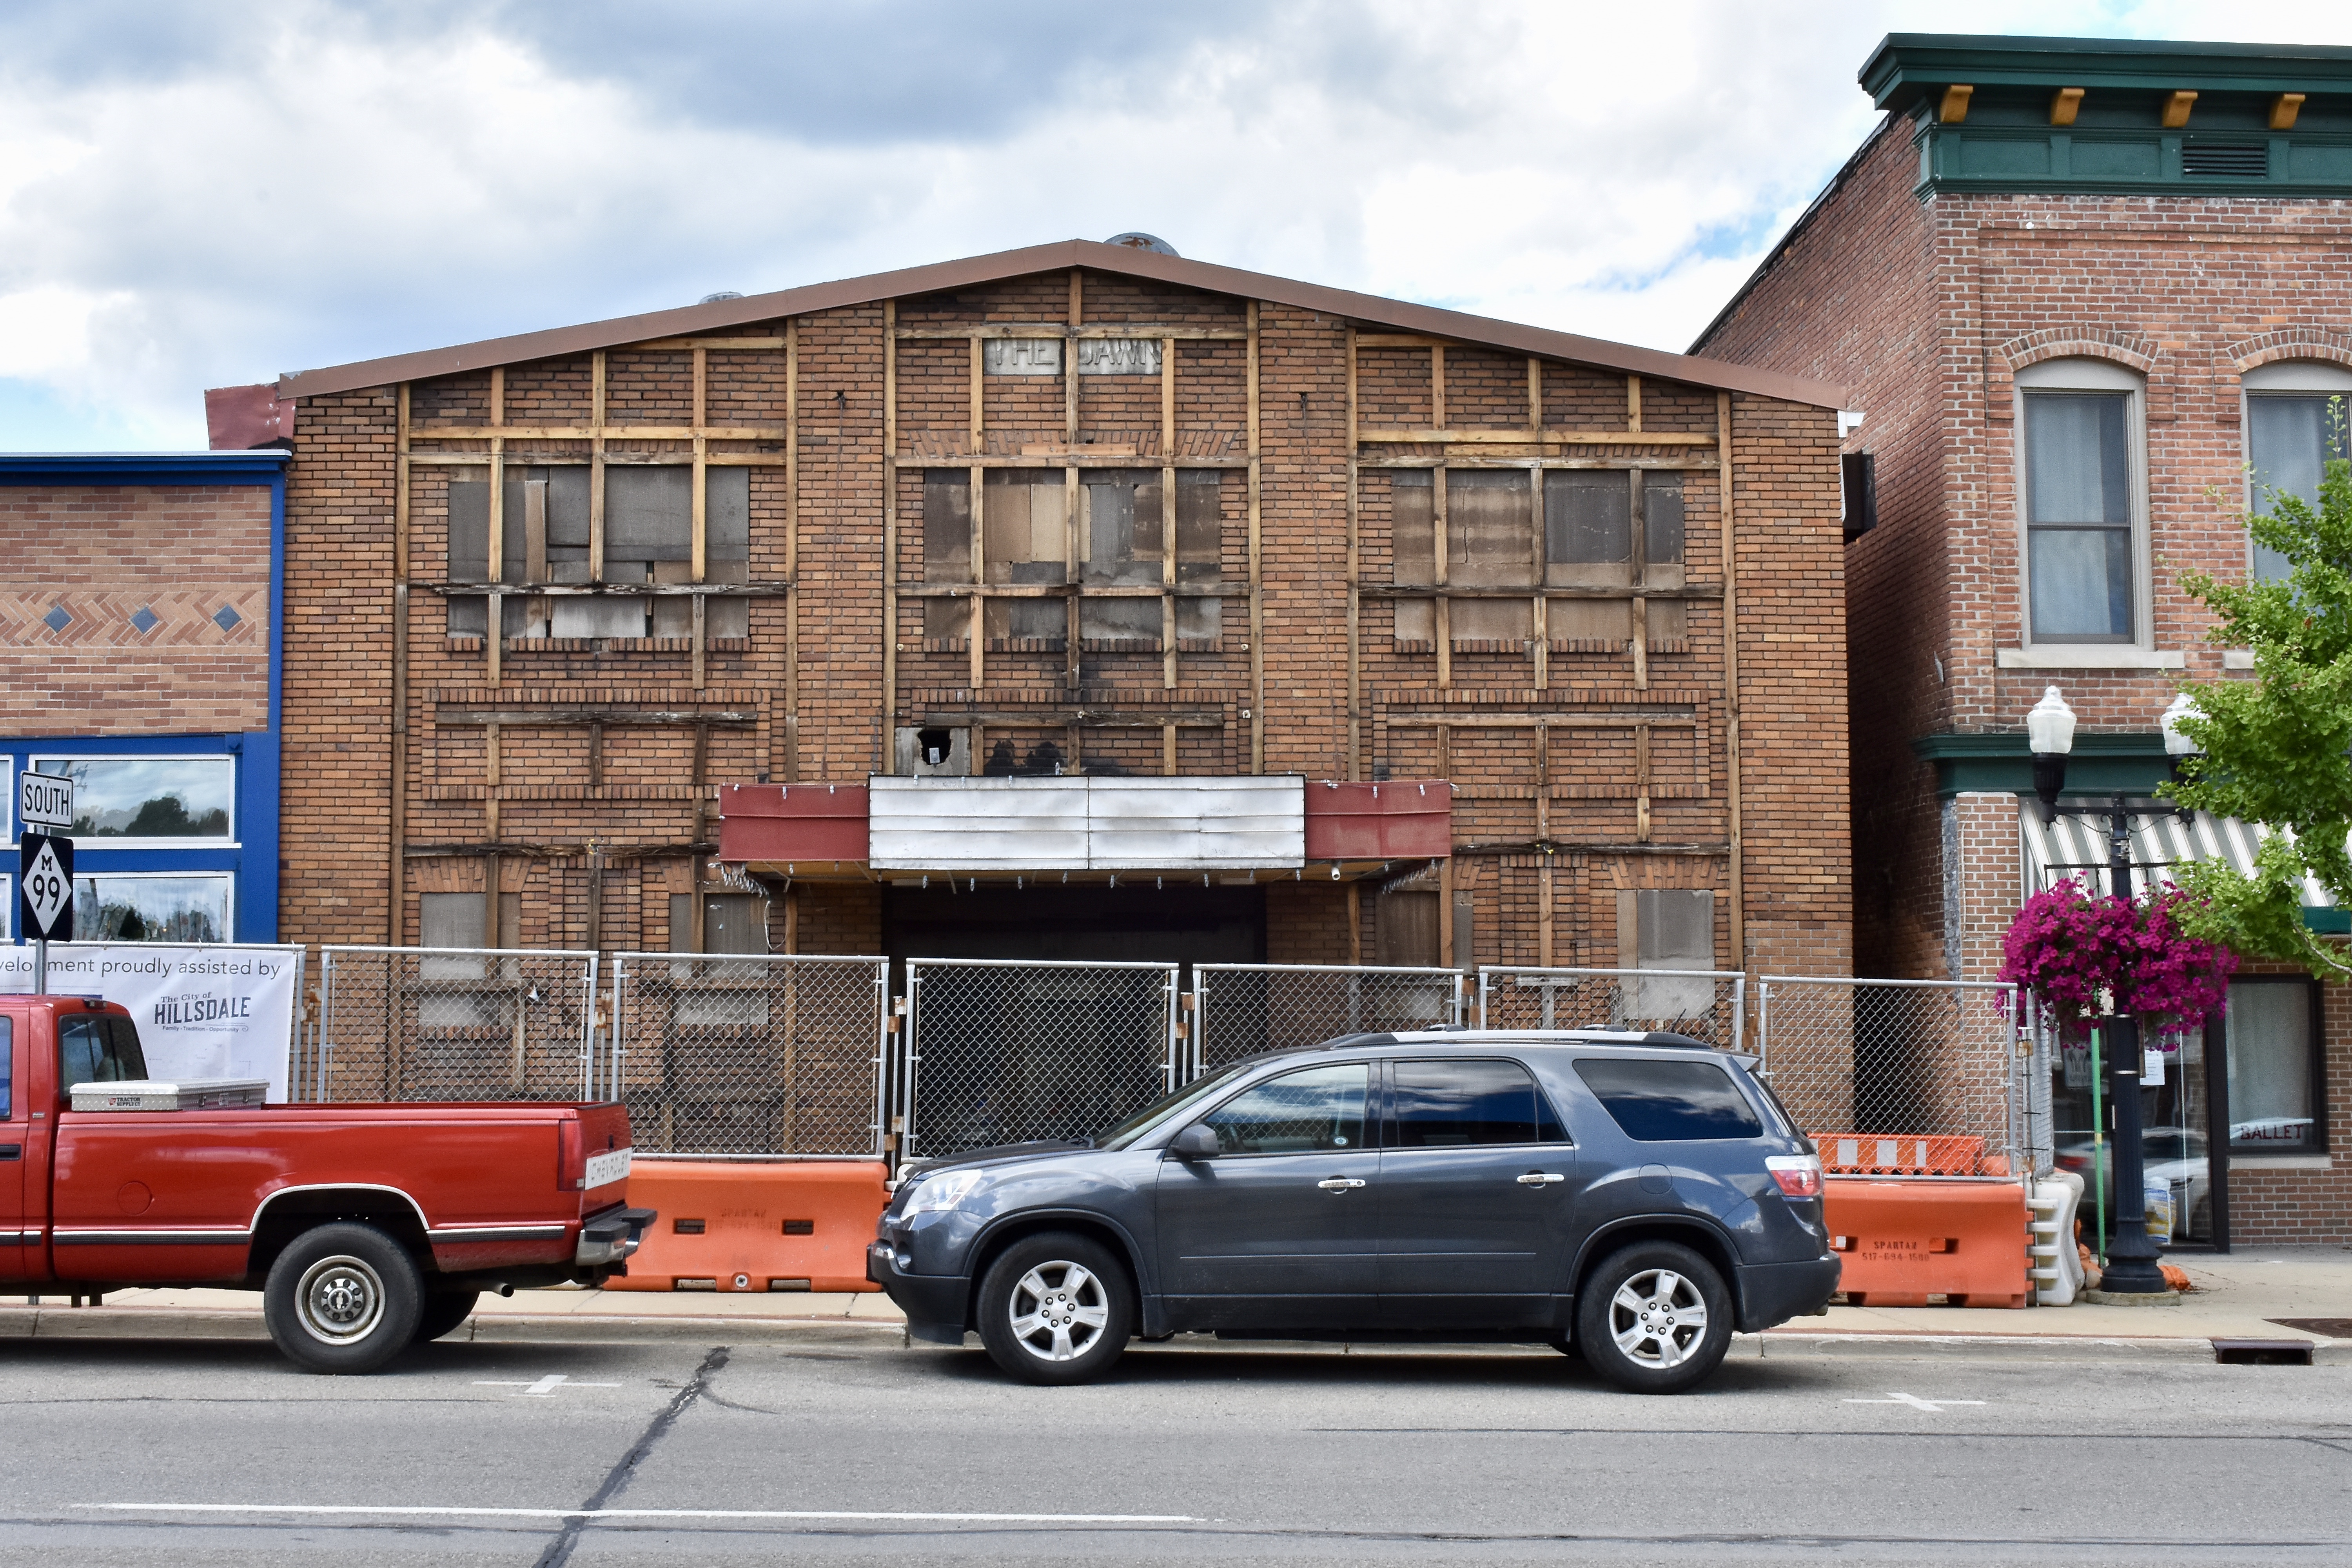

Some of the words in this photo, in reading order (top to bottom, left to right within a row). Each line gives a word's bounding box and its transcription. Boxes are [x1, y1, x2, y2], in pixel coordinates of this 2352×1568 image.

[995, 338, 1054, 365] THE
[24, 784, 69, 816] SOUTH
[41, 855, 52, 871] M
[33, 874, 60, 912] 99
[0, 956, 94, 972] eloment
[102, 958, 172, 978] proudly
[179, 959, 251, 975] assisted
[259, 960, 281, 980] by
[154, 997, 251, 1024] HILLSDALE
[2240, 1124, 2304, 1140] BALLET
[1874, 1241, 1916, 1249] SPARTAN
